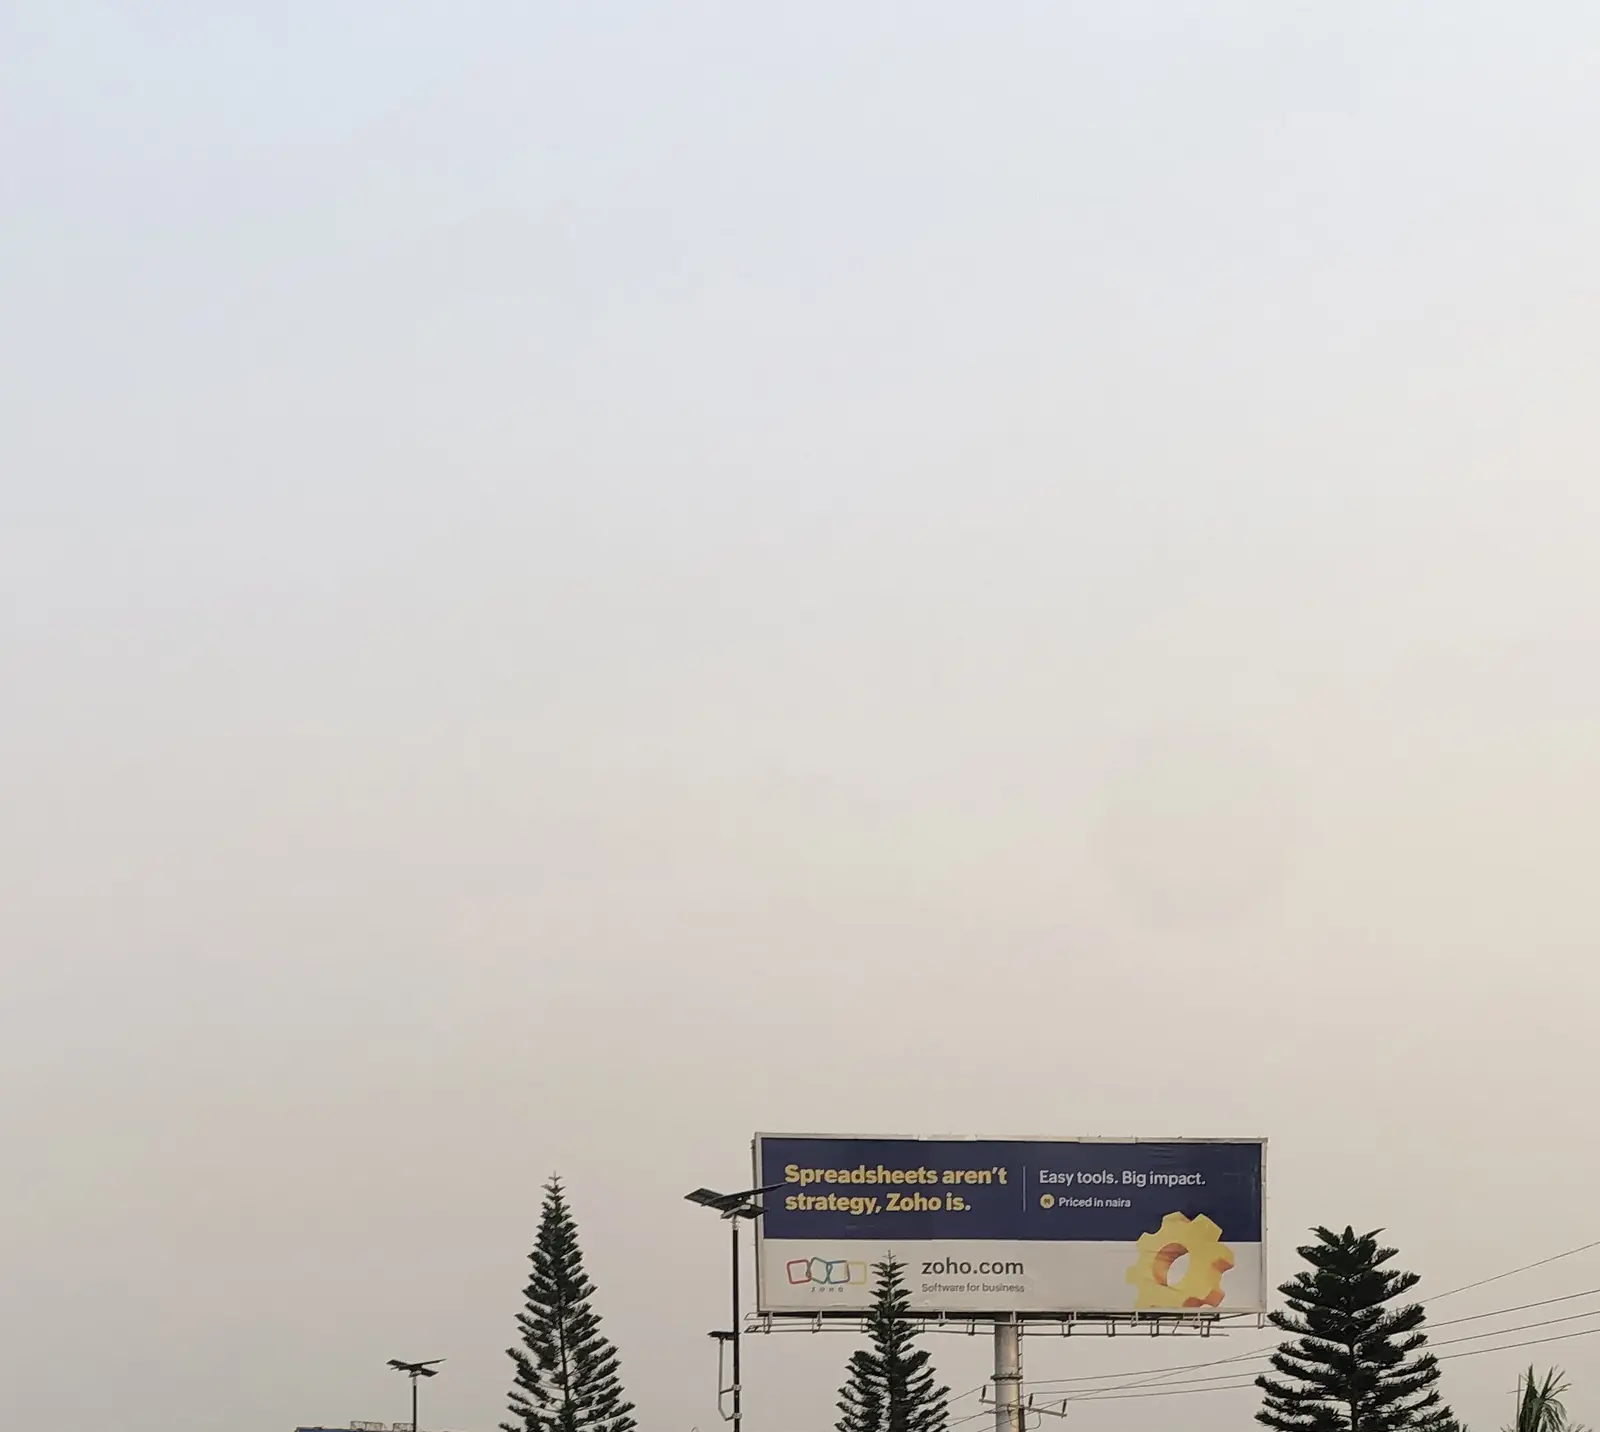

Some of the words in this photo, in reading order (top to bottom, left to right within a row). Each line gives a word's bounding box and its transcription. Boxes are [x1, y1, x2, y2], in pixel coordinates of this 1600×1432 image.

[784, 1164, 938, 1187] Spreadsheets
[1039, 1169, 1074, 1186] Easy
[1077, 1170, 1118, 1184] tools.
[1122, 1170, 1147, 1187] Big
[1150, 1170, 1206, 1188] impact.
[784, 1192, 882, 1215] strategy,
[886, 1191, 942, 1212] Zoho
[946, 1192, 972, 1211] is.
[1058, 1197, 1093, 1208] Priced
[1094, 1197, 1103, 1208] in
[1105, 1197, 1131, 1208] naira
[921, 1257, 1024, 1276] zoho.com
[921, 1283, 965, 1293] Software
[966, 1283, 981, 1293] for
[982, 1283, 1025, 1293] business
